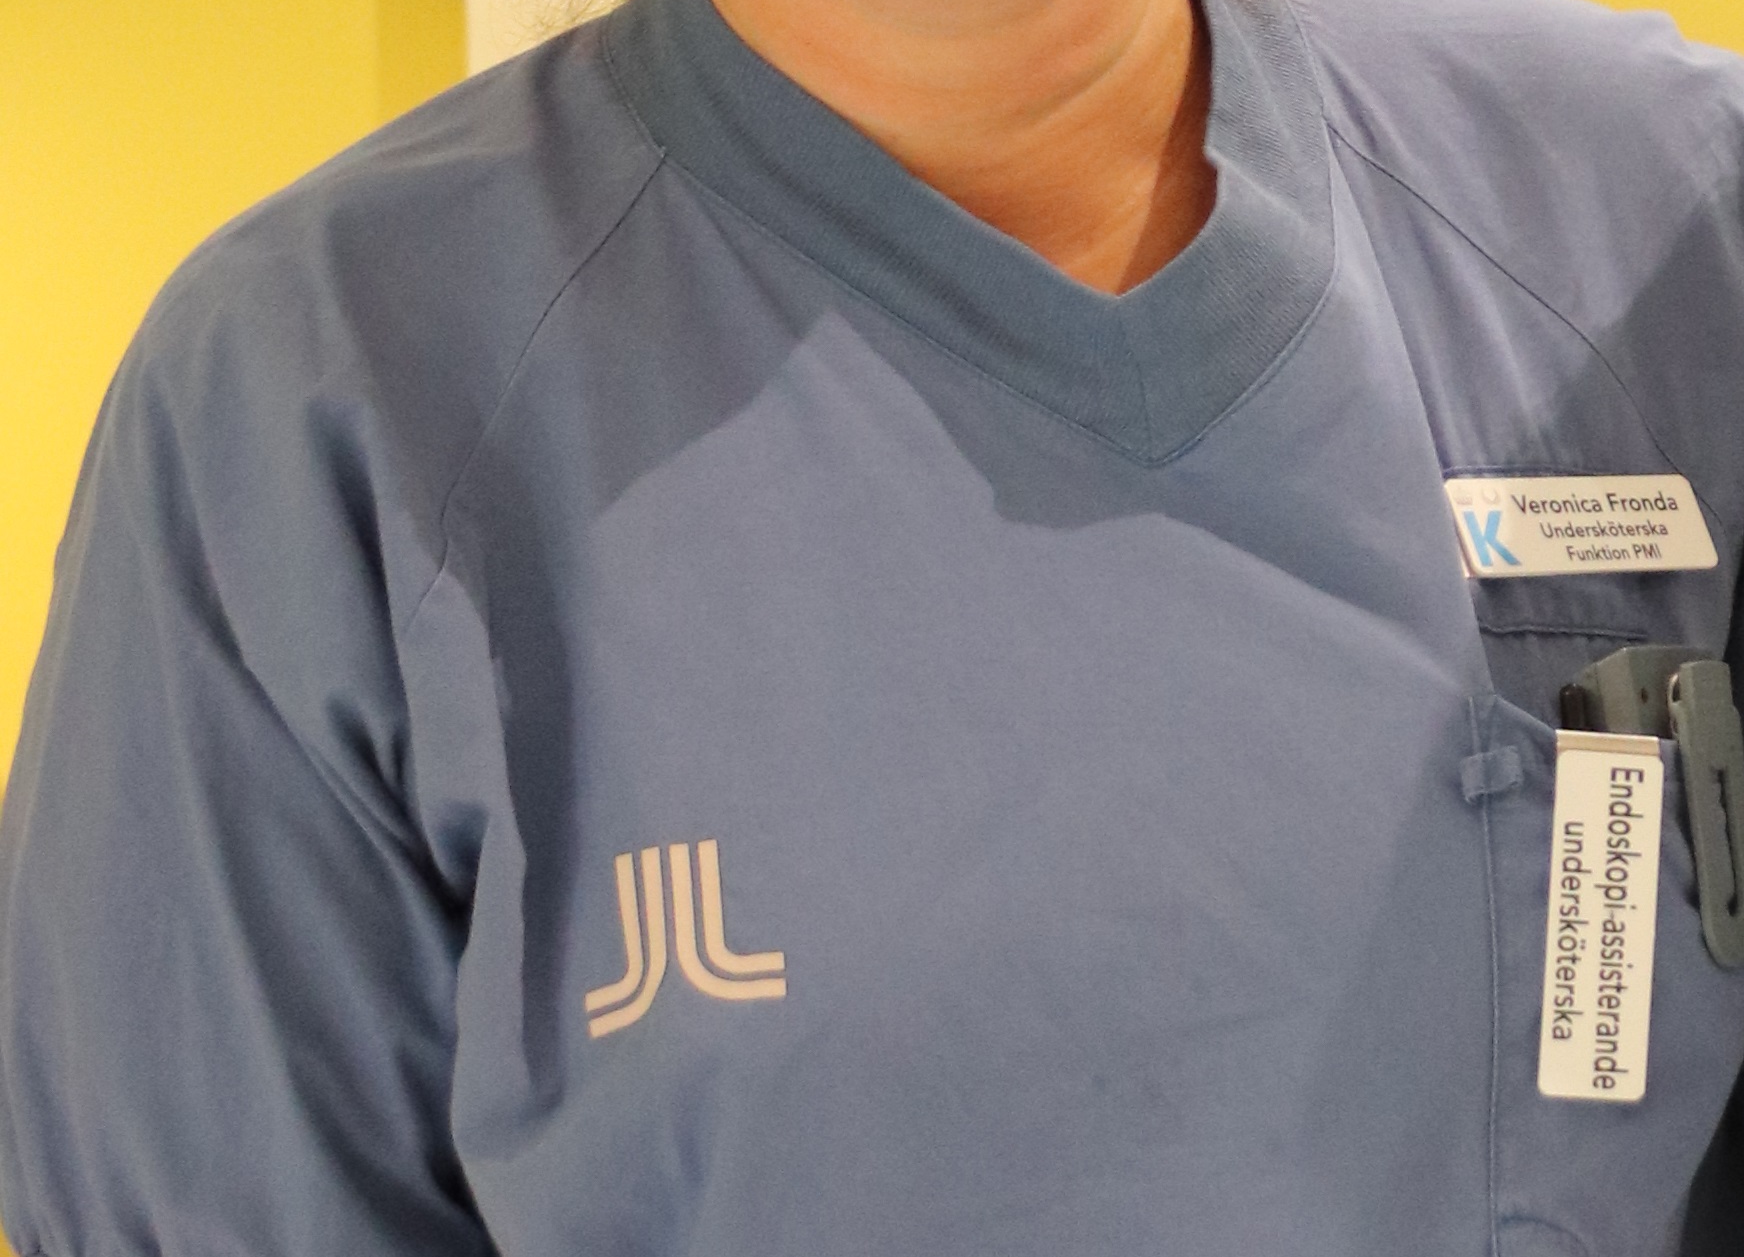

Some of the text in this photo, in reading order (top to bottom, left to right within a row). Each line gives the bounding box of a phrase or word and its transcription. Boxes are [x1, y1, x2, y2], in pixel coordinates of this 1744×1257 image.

[1511, 492, 1679, 515] Veronica Fronda
[1463, 509, 1522, 567] K
[1539, 520, 1669, 539] Undersköterska
[1565, 543, 1662, 562] Funktion PMI
[1551, 820, 1592, 1042] undersköterska
[1592, 765, 1645, 1090] Endoskopi-assisterande
